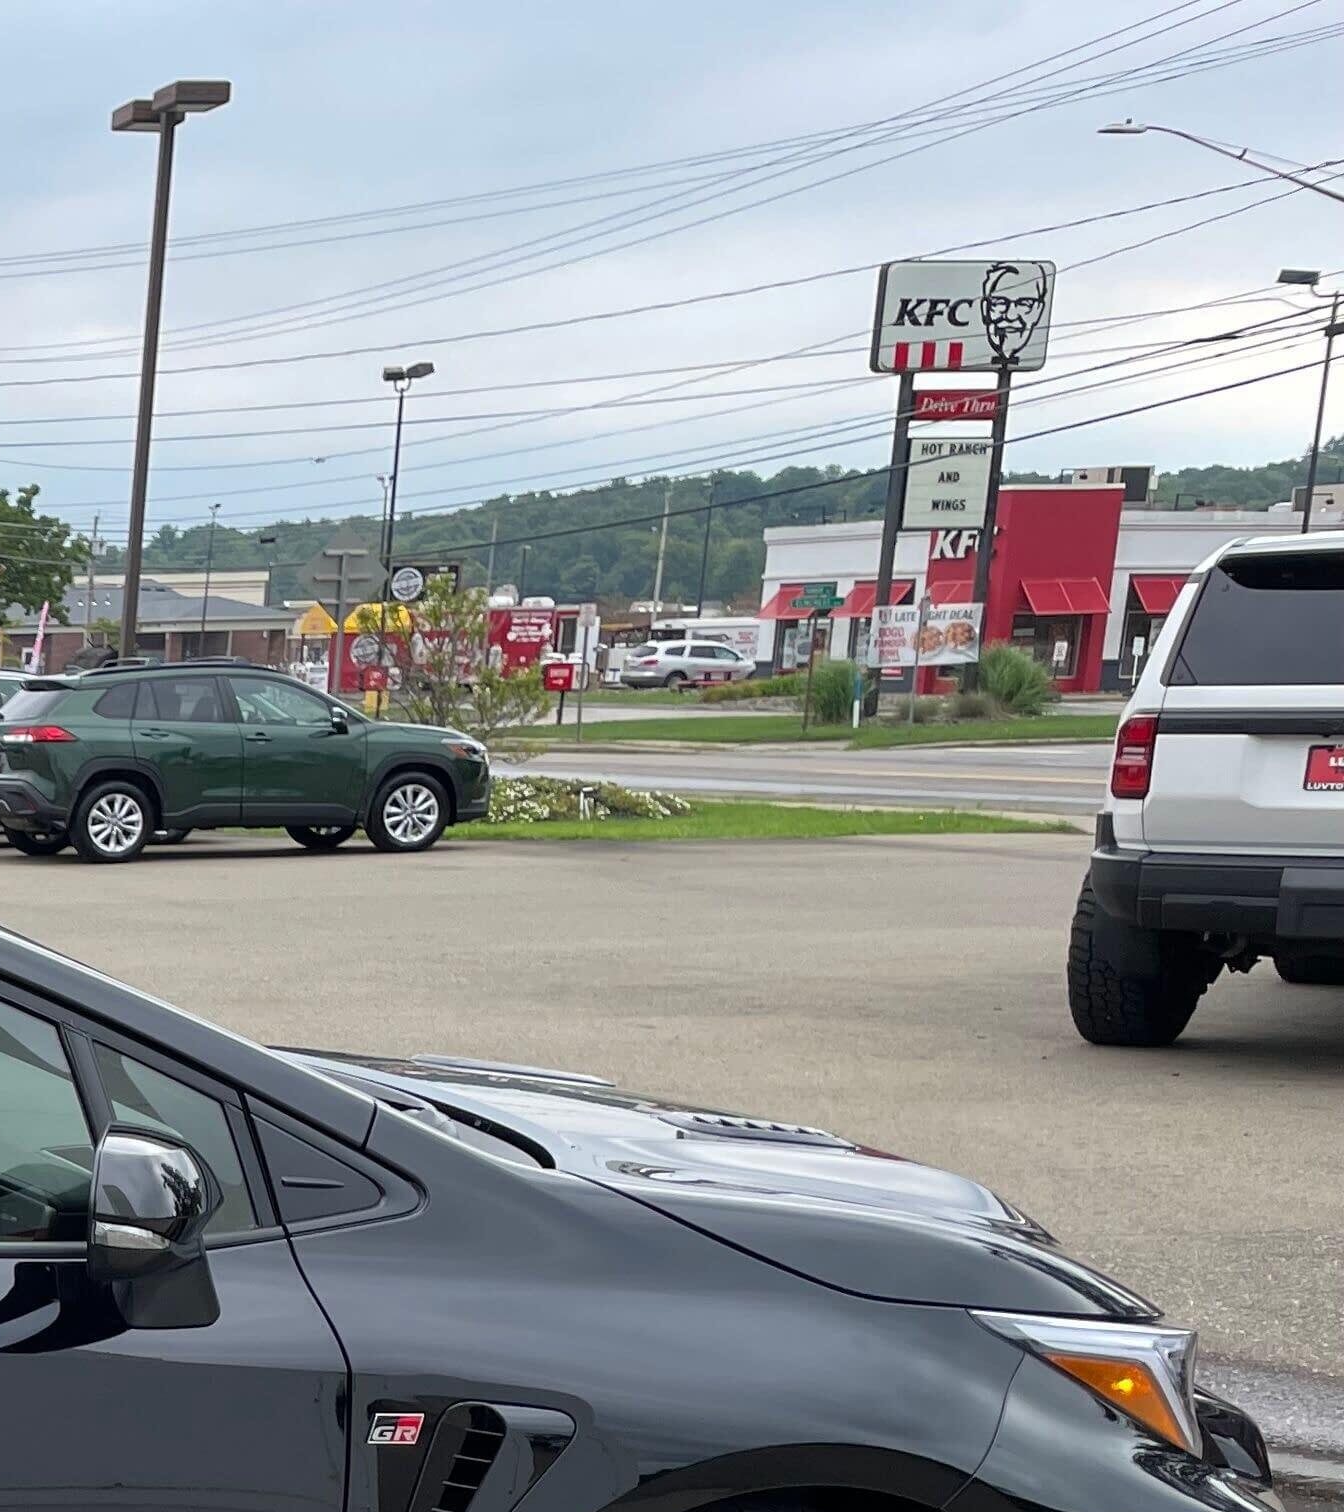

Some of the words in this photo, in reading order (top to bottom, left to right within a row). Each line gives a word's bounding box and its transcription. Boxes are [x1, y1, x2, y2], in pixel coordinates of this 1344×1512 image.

[892, 298, 974, 327] KFC
[921, 397, 958, 412] Drive
[962, 397, 996, 412] Thru
[921, 443, 943, 456] HOT
[949, 443, 988, 456] RANCH
[938, 471, 960, 483] AND
[931, 499, 966, 511] WINGS
[931, 529, 998, 559] KF
[895, 611, 917, 622] LATE
[950, 609, 974, 620] DEAL
[372, 1425, 417, 1441] GR
